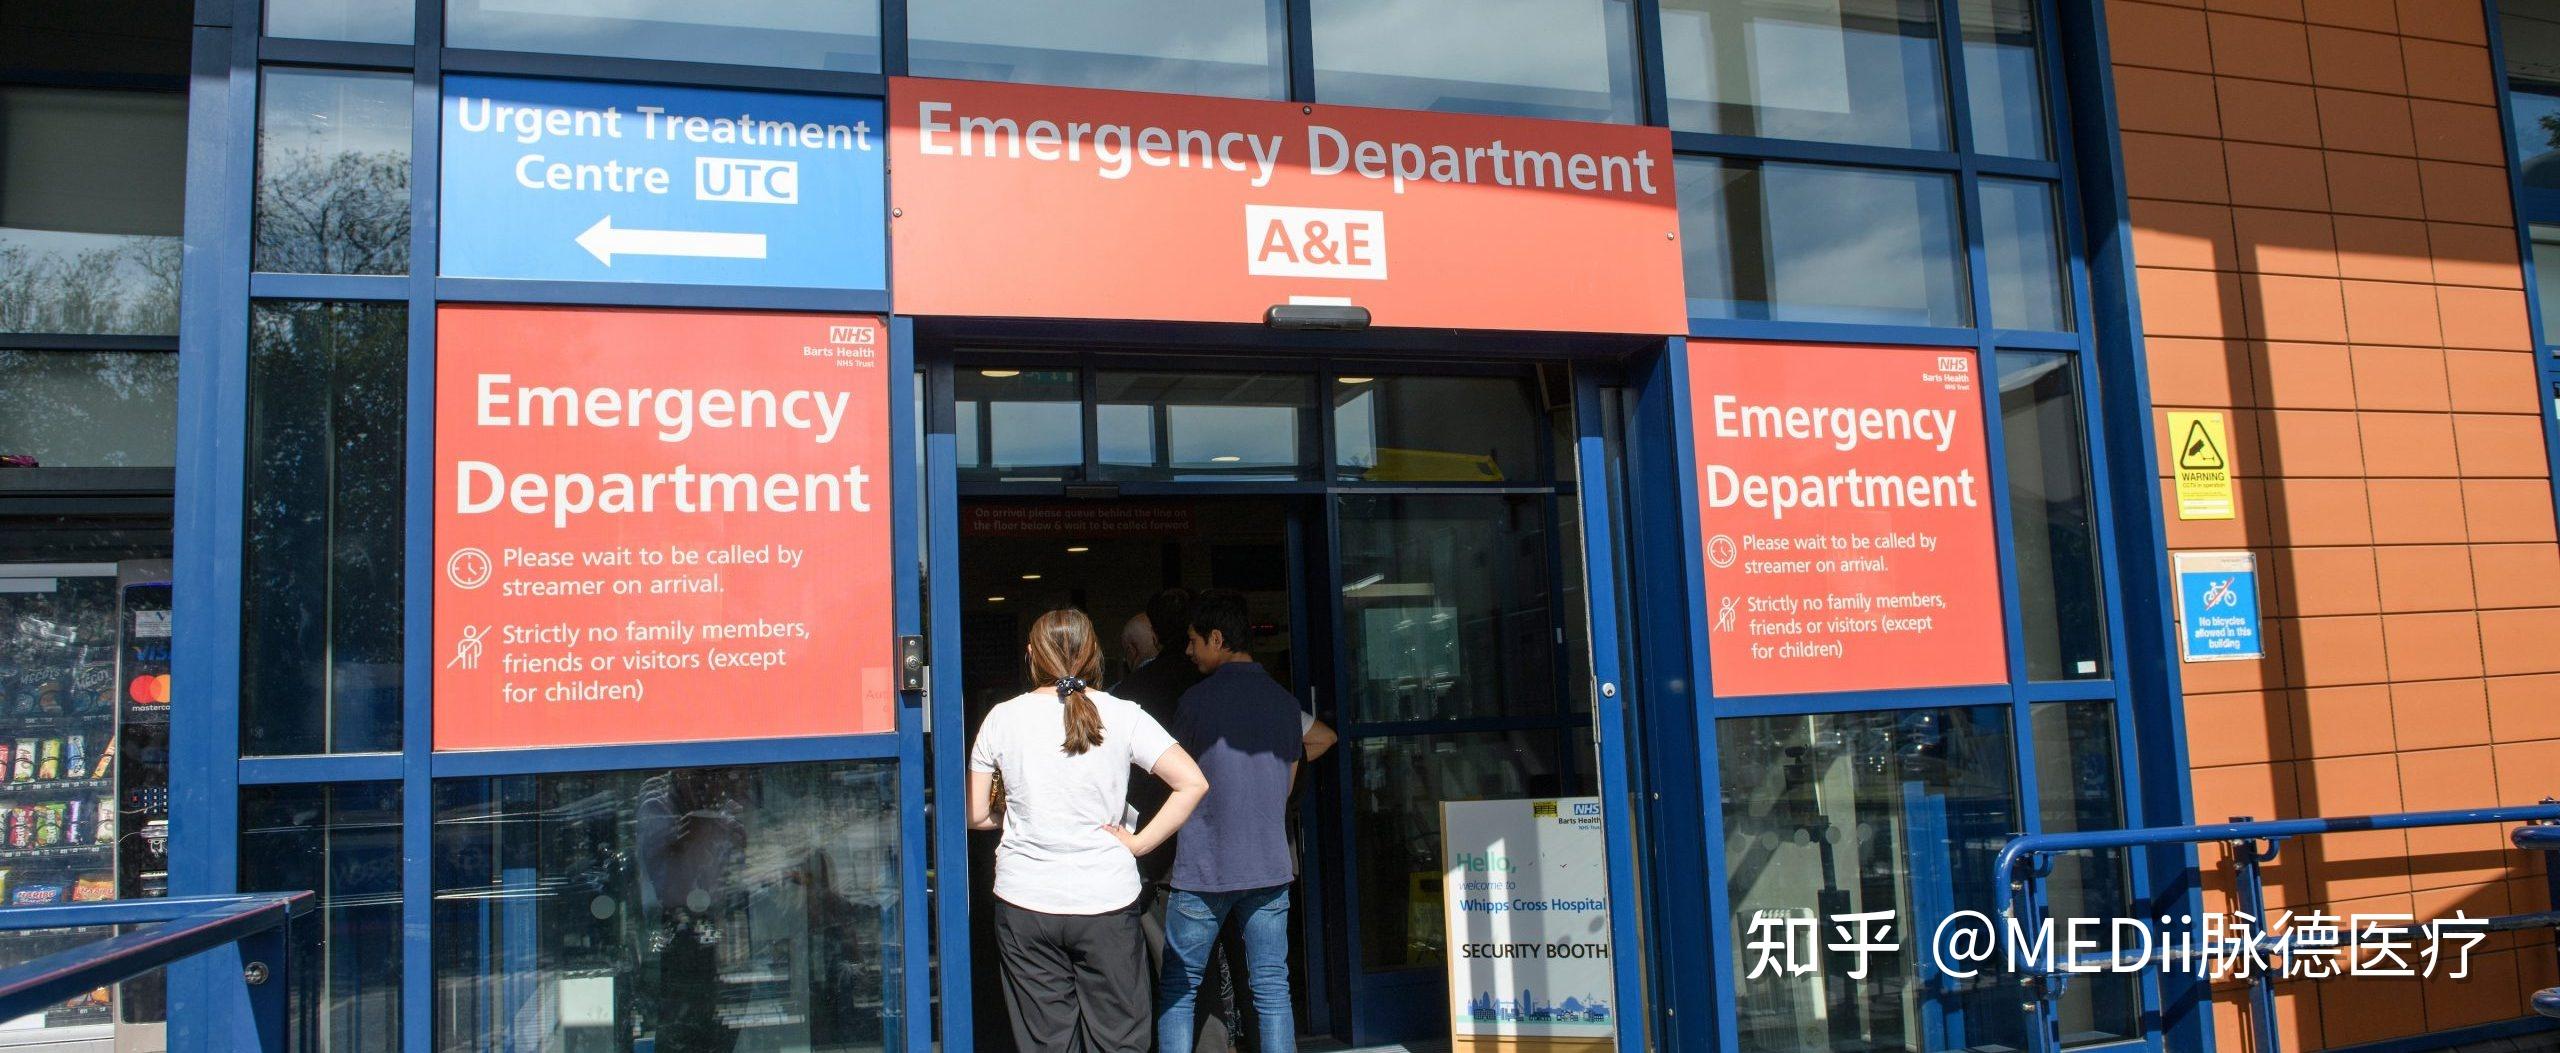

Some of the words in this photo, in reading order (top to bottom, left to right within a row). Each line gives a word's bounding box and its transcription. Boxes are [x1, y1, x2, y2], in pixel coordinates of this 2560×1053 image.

[458, 97, 622, 144] Urgent
[637, 106, 871, 152] Treatment
[918, 101, 1282, 185] Emergency
[1308, 124, 1657, 195] Department
[515, 155, 669, 194] Centre
[702, 162, 791, 198] UTC
[1256, 219, 1372, 267] A&E
[831, 328, 873, 343] NHS
[803, 346, 833, 358] Barts
[837, 347, 875, 358] Health
[1939, 358, 1967, 371] NHS
[1922, 373, 1943, 382] Barts
[1943, 373, 1970, 383] Health
[477, 373, 850, 443] Emergency
[1713, 394, 1957, 452] Emergency
[2181, 472, 2225, 481] WARNING
[457, 460, 871, 529] Department
[1706, 464, 1978, 520] Department
[1743, 535, 1789, 551] Please
[1794, 534, 1827, 550] wait
[1831, 534, 1847, 549] to
[1852, 533, 1870, 549] be
[1874, 533, 1915, 549] called
[1920, 533, 1937, 552] by
[503, 548, 574, 568] Please
[582, 547, 632, 566] wait
[638, 547, 663, 565] to
[671, 545, 699, 565] be
[706, 544, 769, 565] called
[778, 544, 803, 568] by
[1745, 559, 1810, 574] streamer
[1816, 560, 1835, 573] on
[1840, 556, 1888, 572] arrival.
[502, 577, 605, 598] streamer
[613, 579, 642, 595] on
[650, 575, 724, 595] arrival.
[1747, 595, 1798, 615] Strictly
[1803, 598, 1823, 611] no
[1826, 593, 1872, 614] family
[1876, 592, 1946, 611] members,
[1749, 619, 1802, 637] friends
[1807, 621, 1822, 634] or
[1827, 616, 1877, 633] visitors
[1882, 615, 1933, 634] (except
[2199, 617, 2211, 627] No
[2212, 616, 2246, 627] bicycles
[502, 623, 579, 651] Strictly
[588, 626, 618, 642] no
[626, 621, 695, 649] family
[702, 619, 810, 640] members,
[2195, 628, 2226, 638] allowed
[2227, 627, 2235, 637] in
[2237, 627, 2252, 636] this
[1751, 644, 1773, 660] for
[1779, 640, 1843, 659] children)
[2208, 638, 2241, 649] building
[502, 652, 583, 675] friends
[590, 655, 614, 671] or
[622, 650, 700, 670] visitors
[708, 648, 786, 671] (except
[502, 682, 540, 704] for
[545, 678, 644, 702] children)
[132, 704, 171, 712] masterca
[1574, 804, 1600, 815] NHS
[1558, 817, 1577, 825] Barts
[1456, 853, 1517, 874] Hello,
[1459, 881, 1503, 891] welcome
[1505, 881, 1516, 890] to
[1460, 899, 1509, 914] Whipps
[1512, 899, 1548, 911] Cross
[1551, 897, 1606, 913] Hospital
[1462, 943, 1541, 959] SECURITY
[1546, 943, 1609, 959] BOOTH
